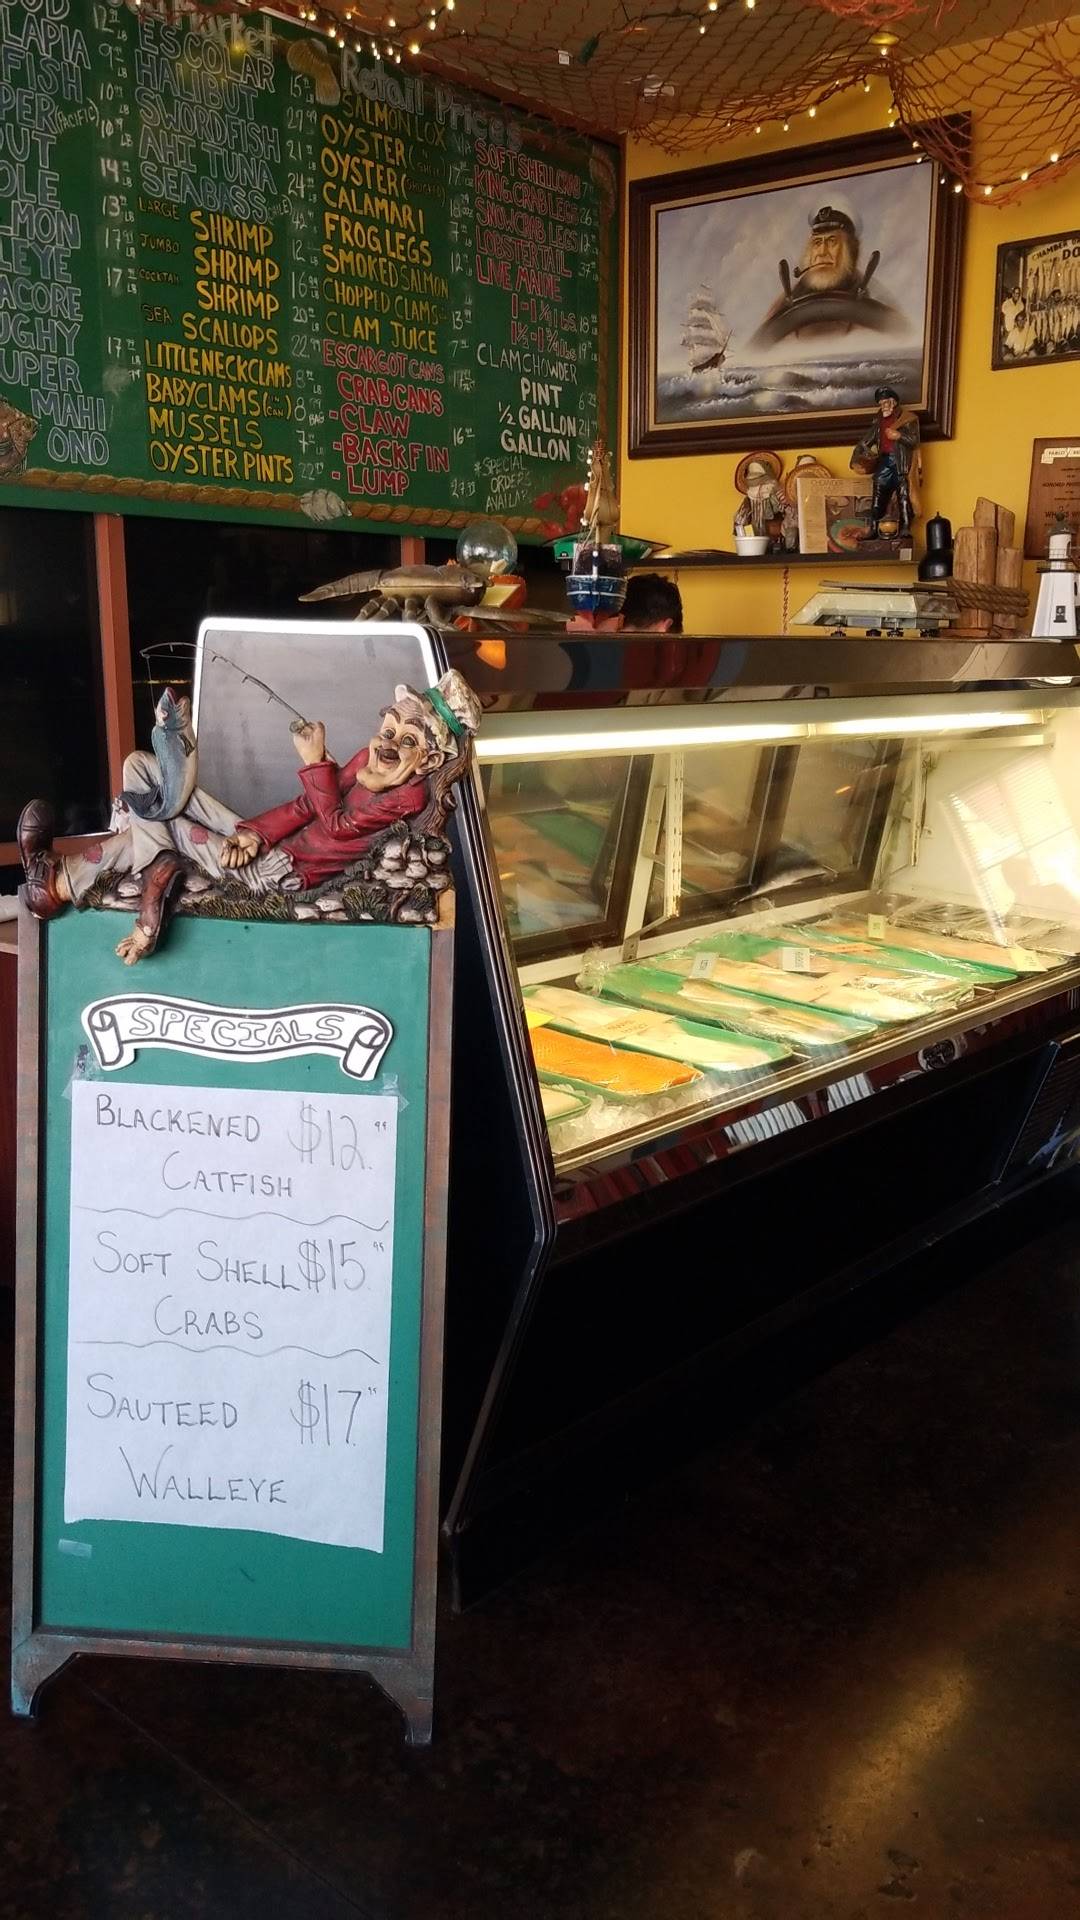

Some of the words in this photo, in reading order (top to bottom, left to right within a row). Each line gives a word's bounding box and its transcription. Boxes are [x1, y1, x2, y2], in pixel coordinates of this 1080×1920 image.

[2, 45, 82, 104] FISH
[138, 13, 275, 94] ESCOLAR
[135, 49, 258, 121] HALIBUT
[135, 87, 280, 163] SWORDFISH
[321, 114, 408, 168] OYSTER
[342, 90, 411, 137] SALMON
[416, 116, 447, 151] LOX
[138, 124, 197, 173] AHI
[201, 142, 278, 195] TUNA
[320, 147, 399, 198] OYSTER
[322, 182, 425, 235] CALAMARI
[474, 165, 513, 204] KING
[513, 182, 552, 216] CRAB
[138, 196, 180, 220] LARGE
[189, 210, 274, 256] SHRIMP
[324, 212, 382, 254] FROG
[385, 229, 432, 267] LEGS
[475, 196, 515, 234] SNOW
[514, 210, 545, 245] CRAB
[549, 221, 578, 252] LEGS
[140, 233, 180, 254] JUMBO
[194, 246, 280, 289] SHRIMP
[322, 244, 399, 288] SMOKED
[400, 265, 449, 300] SALMON
[475, 225, 538, 270] LOBSTER
[538, 244, 573, 278] TAIL
[196, 280, 280, 320] SHRIMP
[323, 278, 391, 314] CHOPPED
[395, 295, 439, 325] CLAMS
[475, 254, 512, 291] LIVE
[515, 265, 562, 302] MAINE
[142, 304, 173, 324] SEA
[182, 312, 279, 356] SCALLOPS
[325, 311, 380, 345] CLAM
[390, 320, 438, 355] JUICE
[322, 339, 407, 378] ESCARGOT
[409, 359, 445, 384] CANS
[30, 389, 106, 432] MAHI
[337, 371, 392, 407] CRAB
[393, 384, 444, 417] CANS
[520, 376, 563, 409] PINT
[47, 426, 109, 466] ONO
[149, 406, 263, 450] MUSSELS
[500, 429, 571, 463] GALLON
[518, 405, 577, 438] GALLON
[150, 440, 240, 480] OYSTER
[243, 450, 294, 484] PINTS
[129, 1005, 345, 1048] SPECIALS
[95, 1093, 260, 1142] BLACKENED
[162, 1150, 293, 1198] CATFISH
[93, 1231, 172, 1277] SOFT
[197, 1240, 300, 1291] SHELL
[154, 1295, 263, 1340] CRABS
[86, 1373, 238, 1429] SAUTEED
[118, 1444, 288, 1504] WALLEYE
